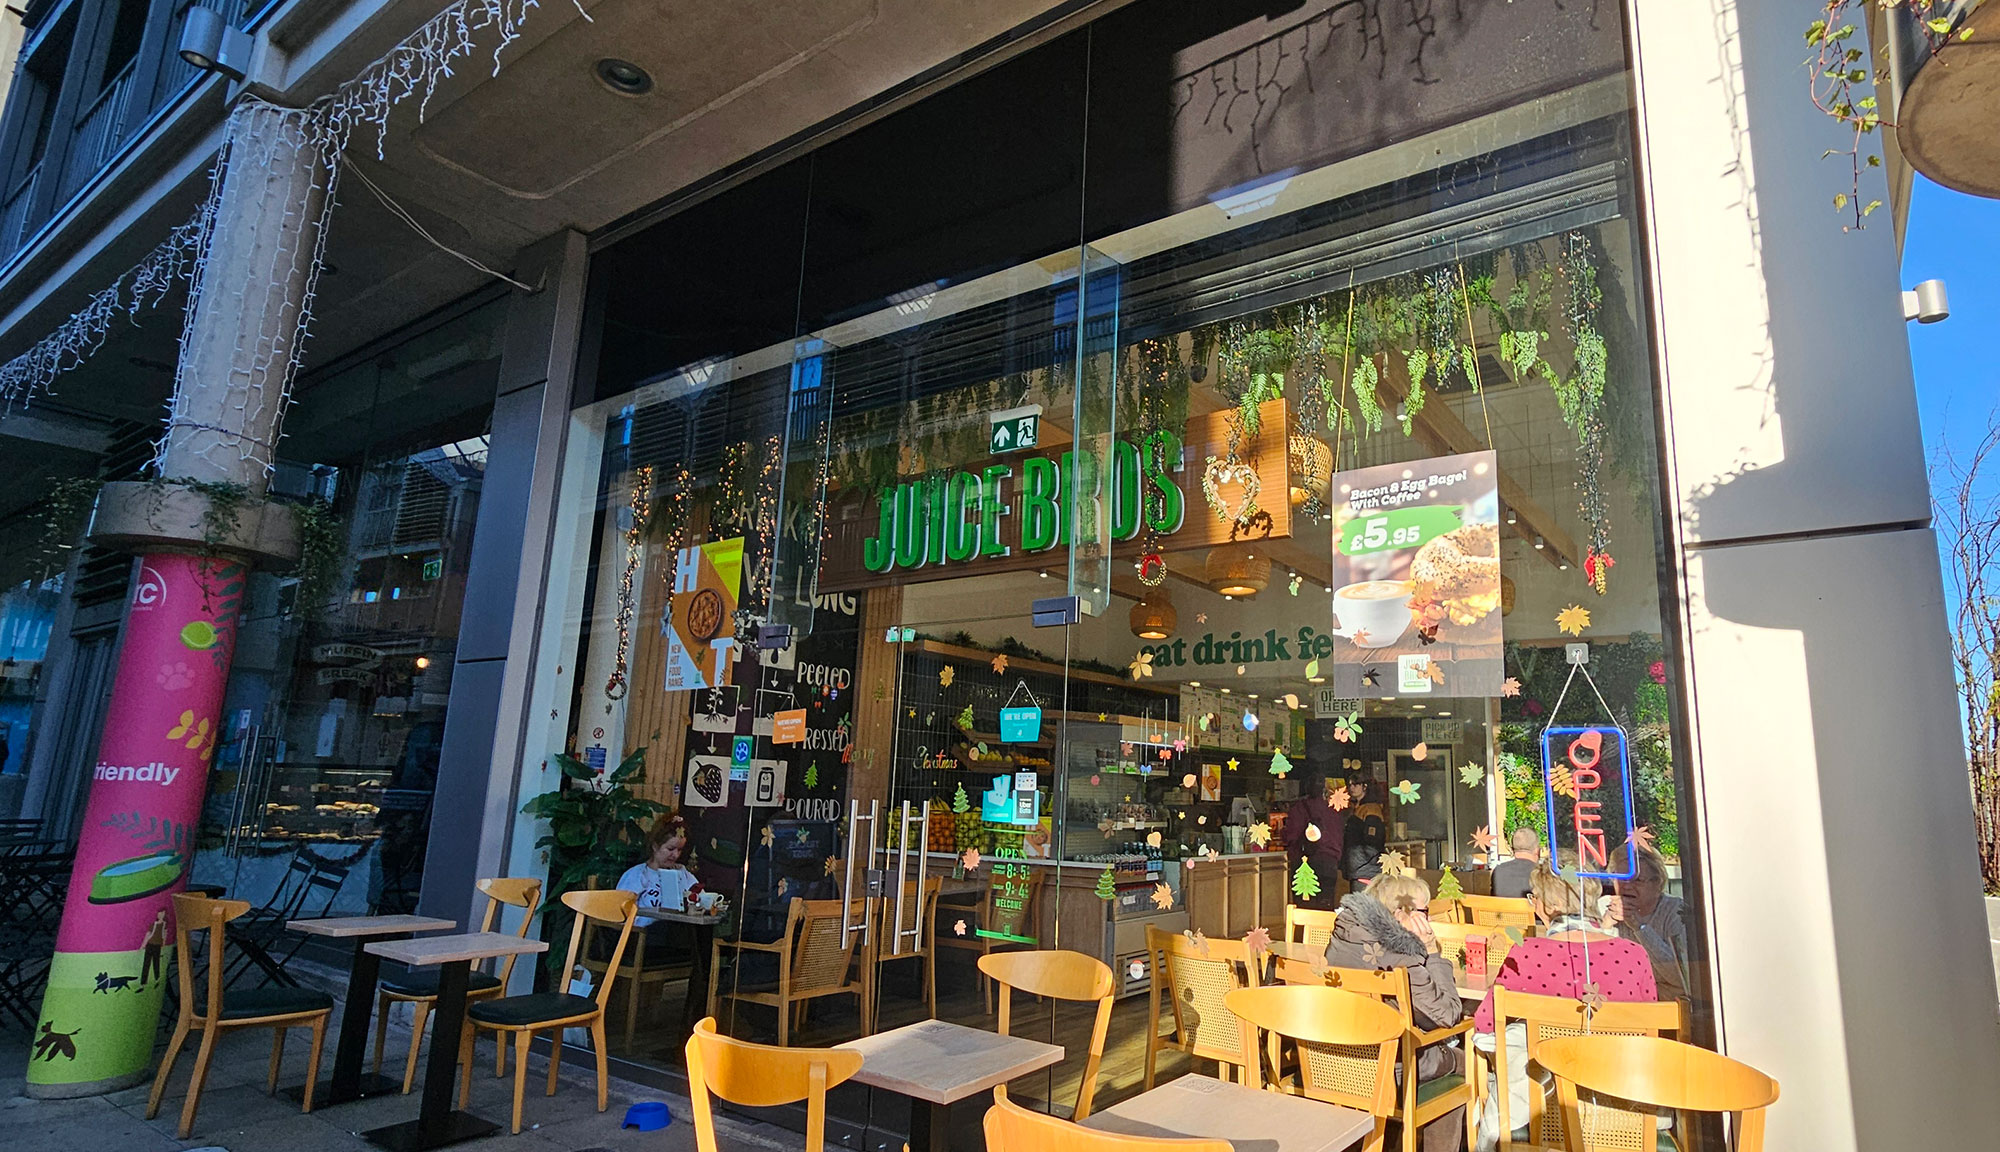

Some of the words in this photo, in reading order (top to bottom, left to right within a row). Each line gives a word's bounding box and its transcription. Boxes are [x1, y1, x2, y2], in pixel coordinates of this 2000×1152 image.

[1350, 486, 1389, 501] Bacon
[1389, 482, 1399, 494] &
[1400, 479, 1427, 492] Egg
[1427, 470, 1467, 487] Bagel
[1350, 496, 1380, 511] With
[1381, 491, 1421, 506] Coffee
[864, 463, 1012, 573] JUICE
[1021, 430, 1185, 554] BROS
[1350, 517, 1420, 552] £5.95
[1140, 637, 1187, 668] eat
[1193, 629, 1291, 666] drink
[1297, 626, 1334, 660] fe
[1322, 701, 1358, 712] HERE
[94, 762, 180, 786] riendly
[1568, 735, 1607, 867] OPEN
[995, 847, 1028, 860] OPEN
